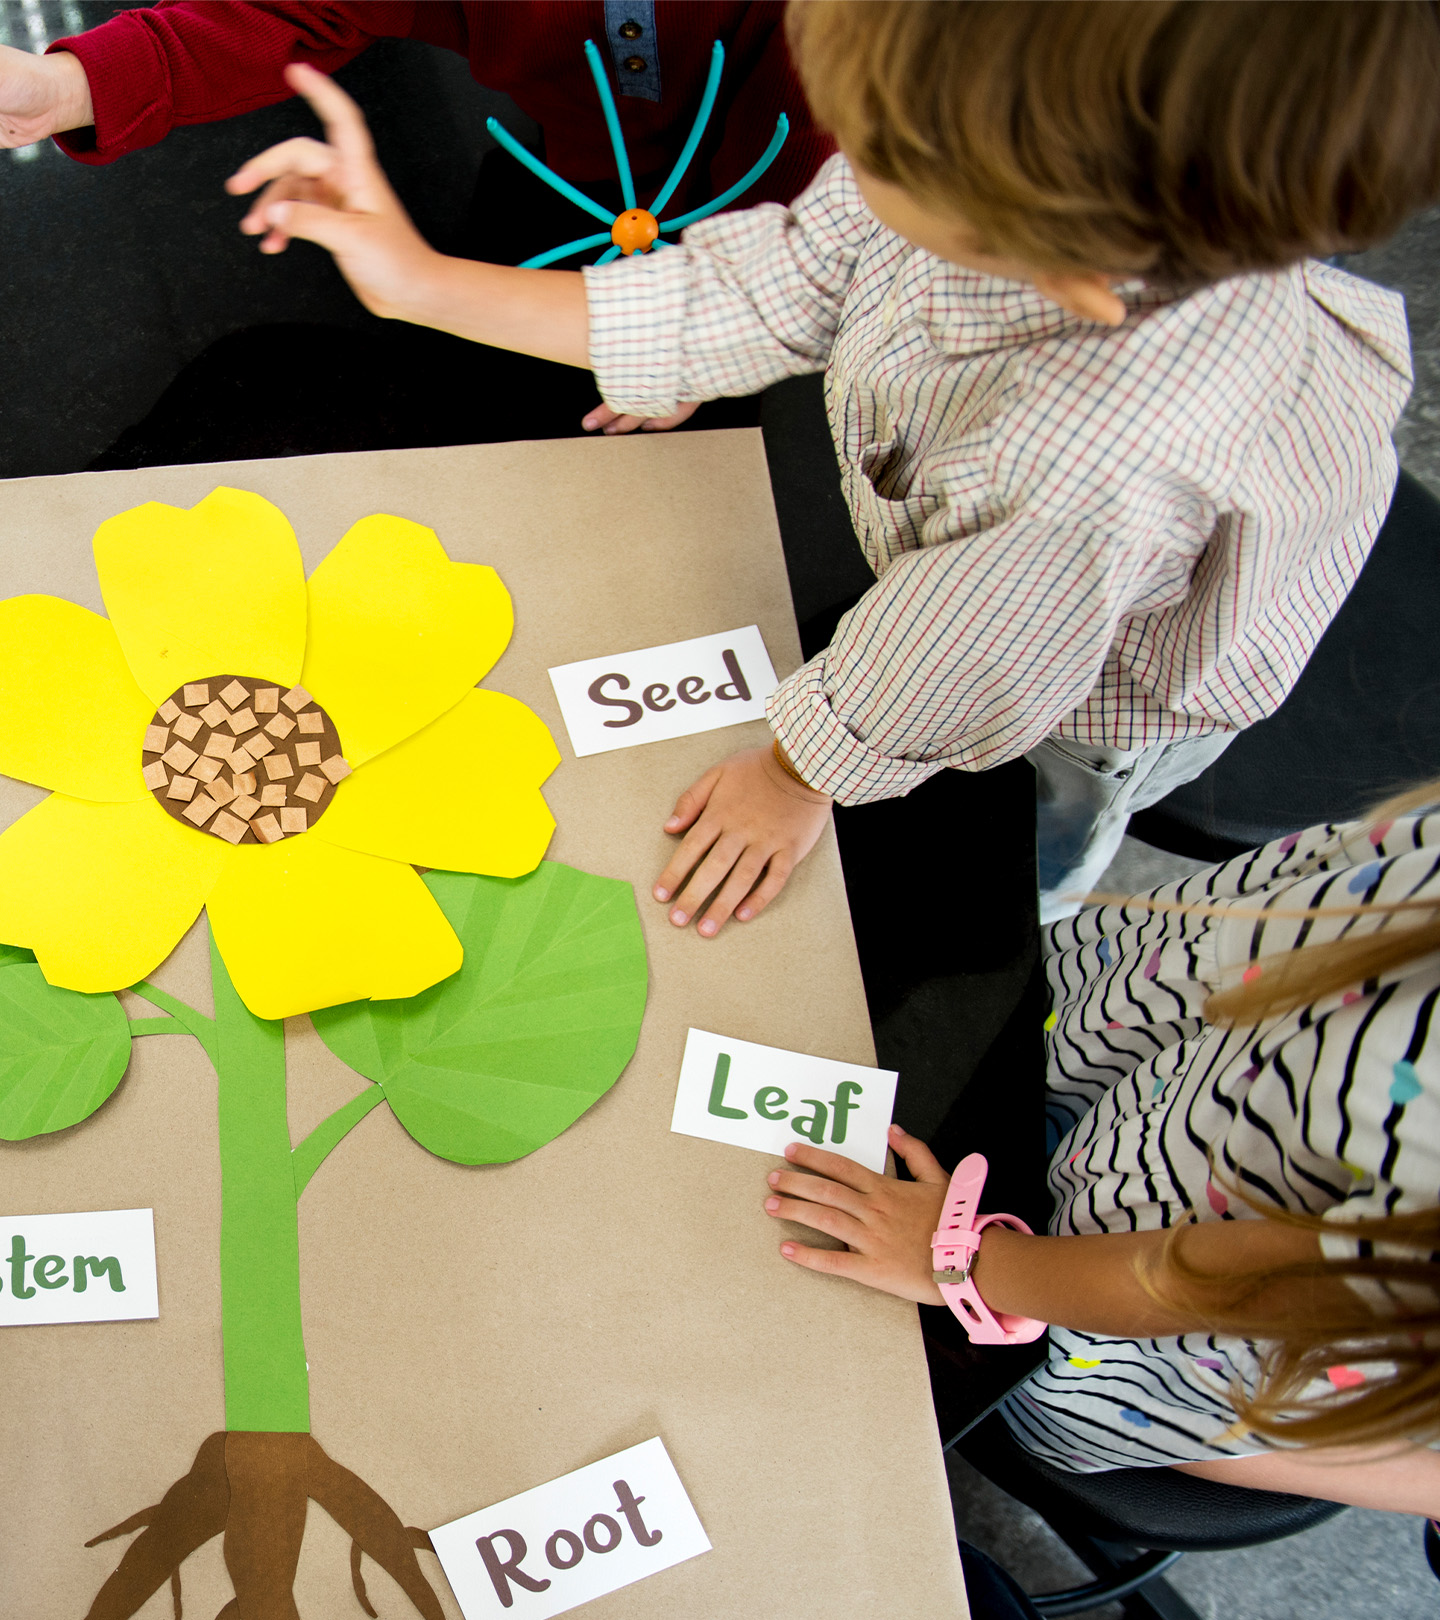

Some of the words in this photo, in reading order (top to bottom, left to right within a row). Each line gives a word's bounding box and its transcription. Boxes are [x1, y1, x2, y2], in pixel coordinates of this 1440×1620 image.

[588, 649, 752, 728] Seed
[708, 1053, 863, 1145] Leaf
[475, 1480, 663, 1608] Root
